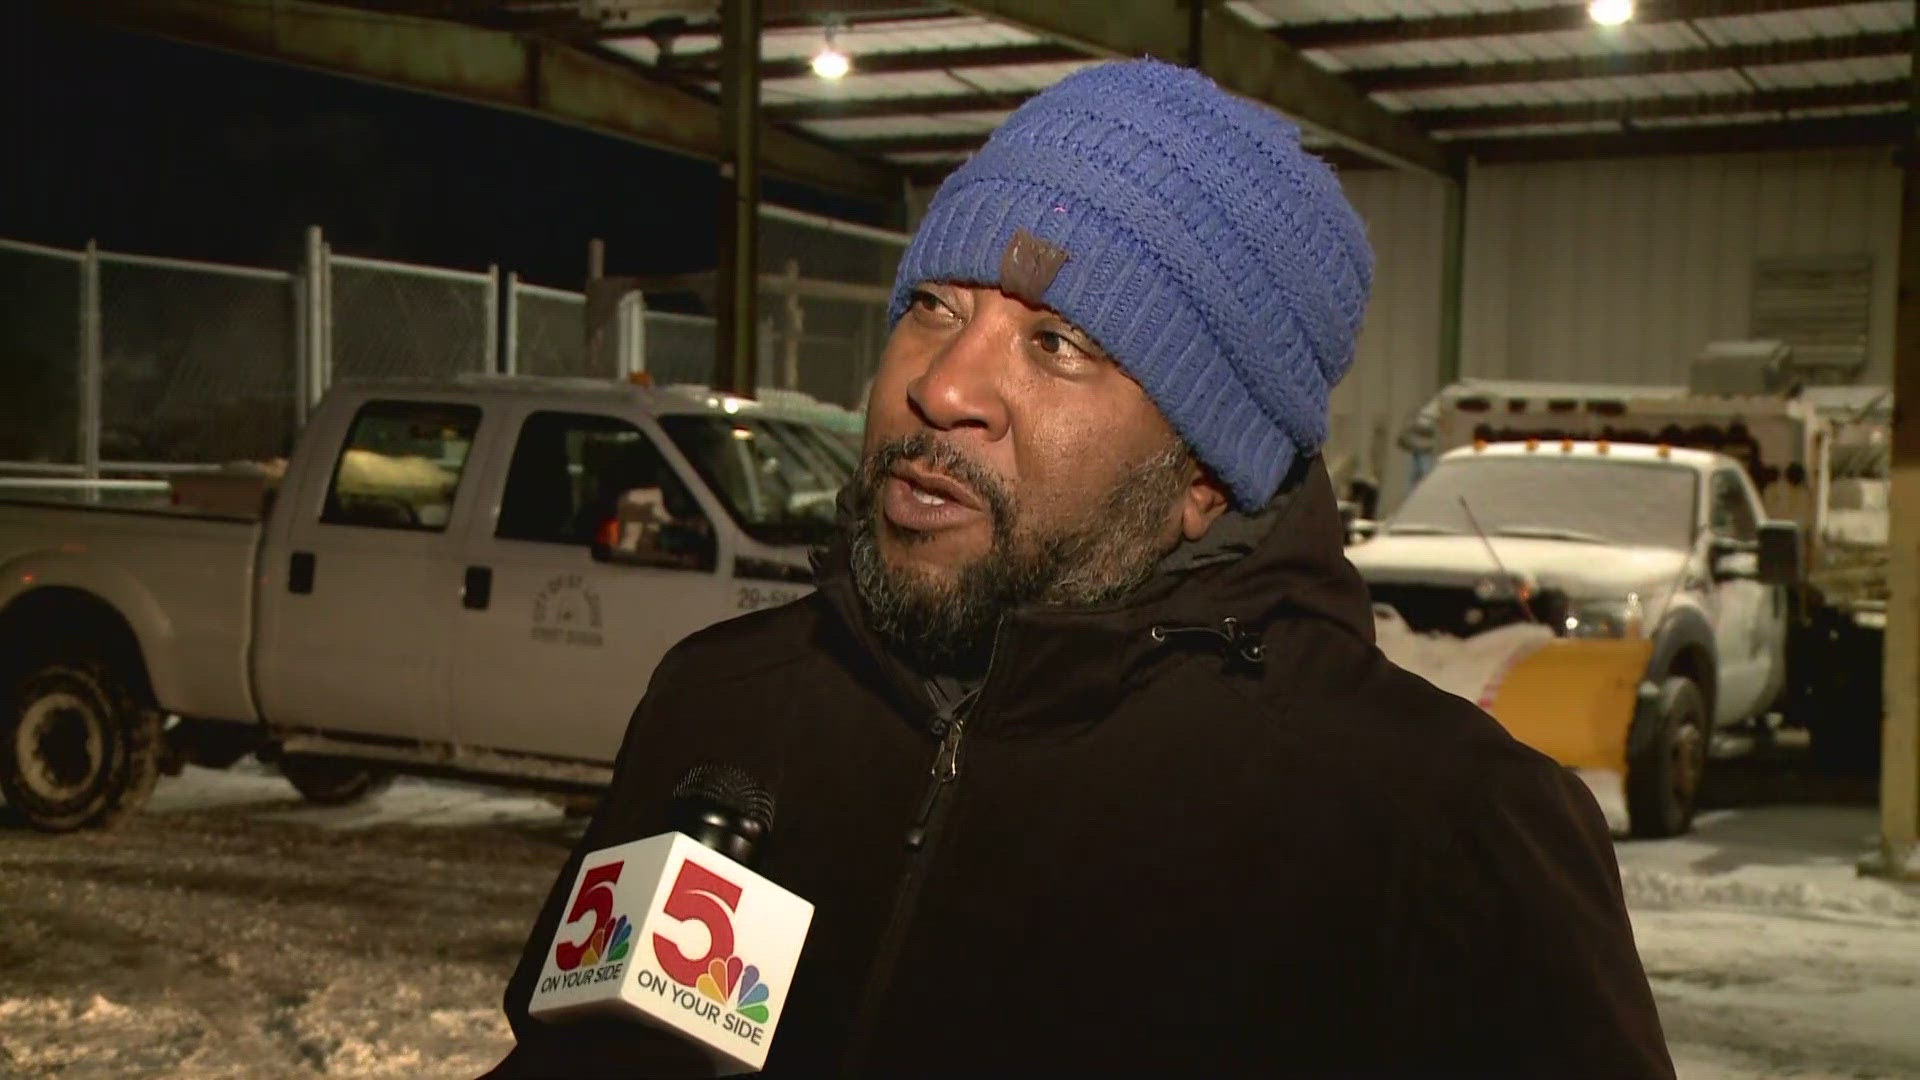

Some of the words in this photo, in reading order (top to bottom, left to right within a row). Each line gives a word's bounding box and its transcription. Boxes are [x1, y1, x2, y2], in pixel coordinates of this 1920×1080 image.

[556, 860, 625, 972] 5
[653, 858, 743, 988] 5
[541, 975, 561, 994] ON
[562, 969, 595, 989] YOUR
[594, 963, 623, 983] SIDE
[638, 969, 667, 997] ON
[669, 984, 721, 1024] YOUR
[722, 1013, 764, 1046] SIDE
